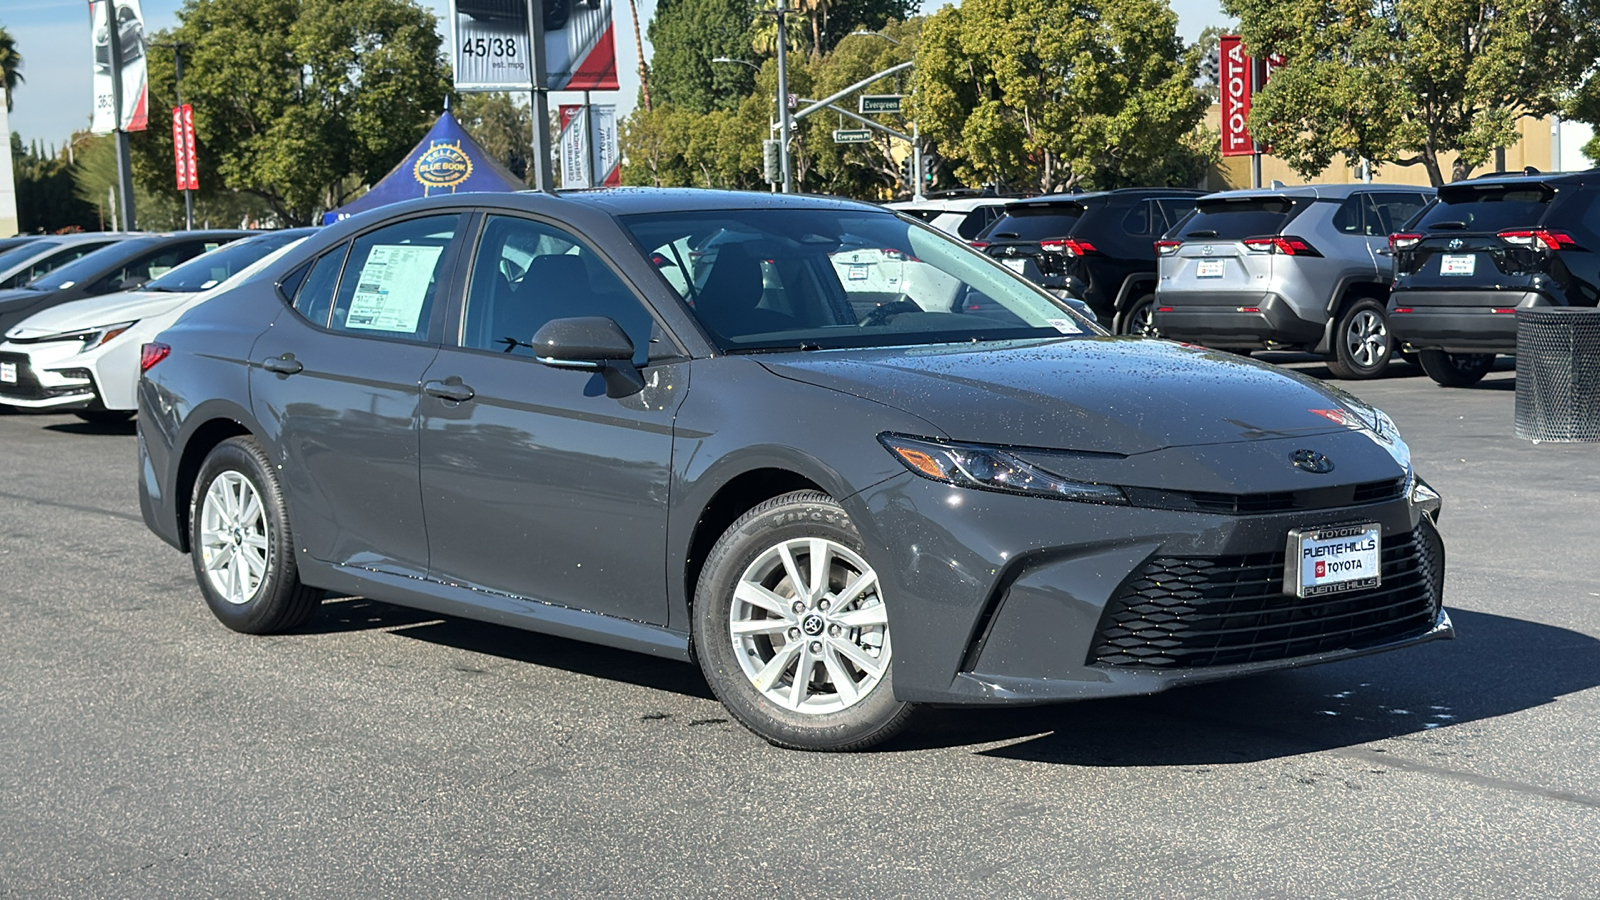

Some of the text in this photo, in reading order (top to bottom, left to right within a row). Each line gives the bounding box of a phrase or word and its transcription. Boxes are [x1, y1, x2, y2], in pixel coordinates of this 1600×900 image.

[463, 38, 516, 57] 45/38
[492, 61, 524, 70] est. mpg
[1229, 44, 1244, 149] TOYOTA
[864, 101, 898, 111] Evergreen
[573, 123, 581, 160] VEHICLES
[426, 149, 464, 162] KELLEY
[567, 143, 575, 182] CERTIFIED
[420, 162, 466, 172] BLUE BOOK
[1320, 527, 1361, 539] TOYOTA
[1303, 540, 1376, 559] PUENTE HILLS
[1327, 559, 1362, 573] TOYOTA
[1305, 578, 1377, 596] PUENTE HILLS
